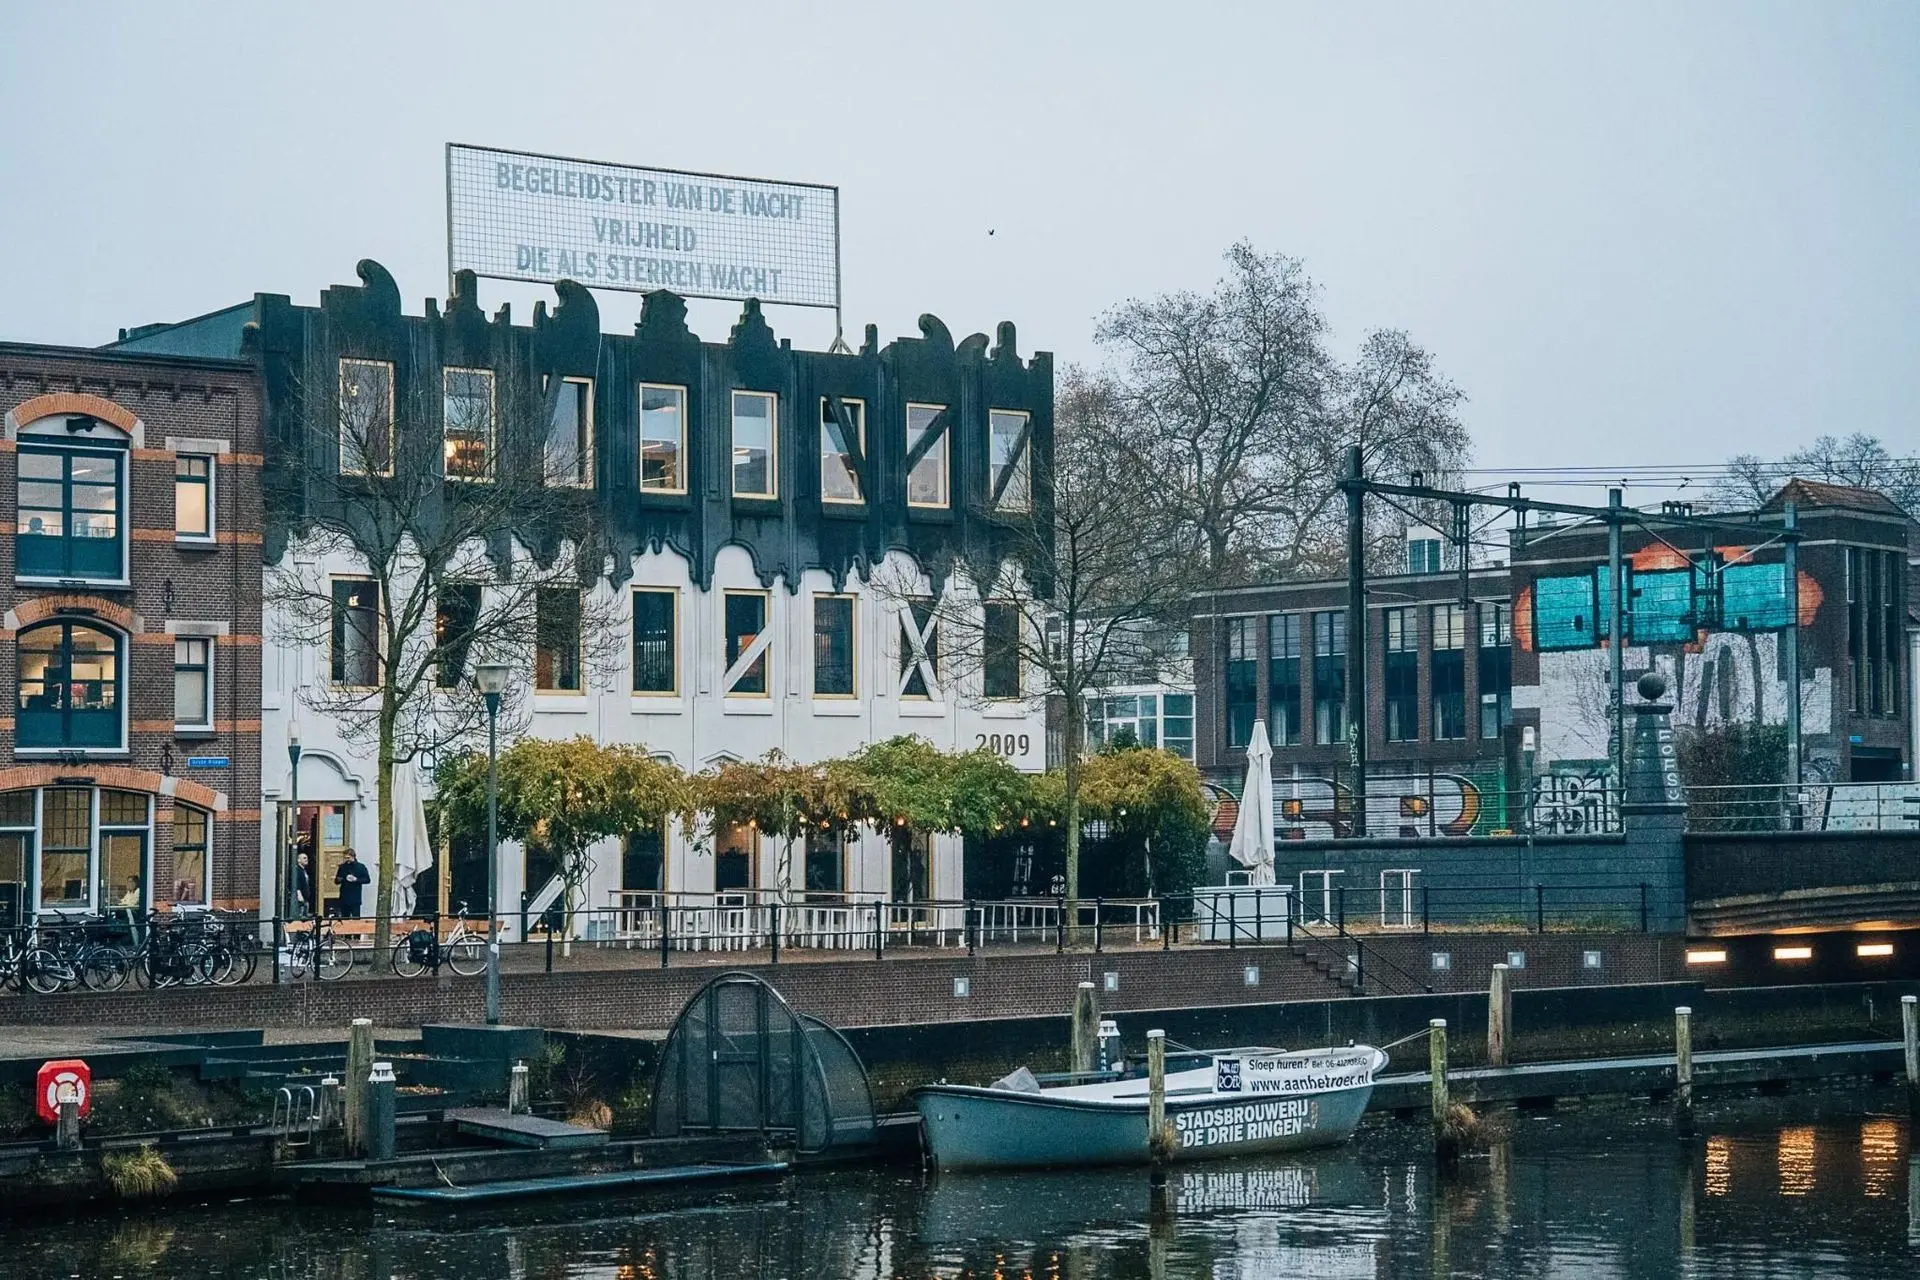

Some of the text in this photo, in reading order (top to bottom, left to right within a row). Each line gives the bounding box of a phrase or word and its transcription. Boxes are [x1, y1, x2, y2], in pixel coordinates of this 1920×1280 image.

[497, 161, 804, 220] BEGELEIDSTER VAN DE NACHT
[592, 216, 697, 252] VRIJHEID
[516, 244, 781, 293] DIE ALS STERREN WACHT
[975, 733, 1030, 756] 2009
[1249, 1059, 1275, 1072] Sloep
[1276, 1058, 1309, 1070] huren?
[1250, 1070, 1369, 1092] www.aanhetroer.nl
[1176, 1099, 1309, 1131] STADSBROUWERIJ
[1183, 1117, 1302, 1148] DE DRIE RINGEN
